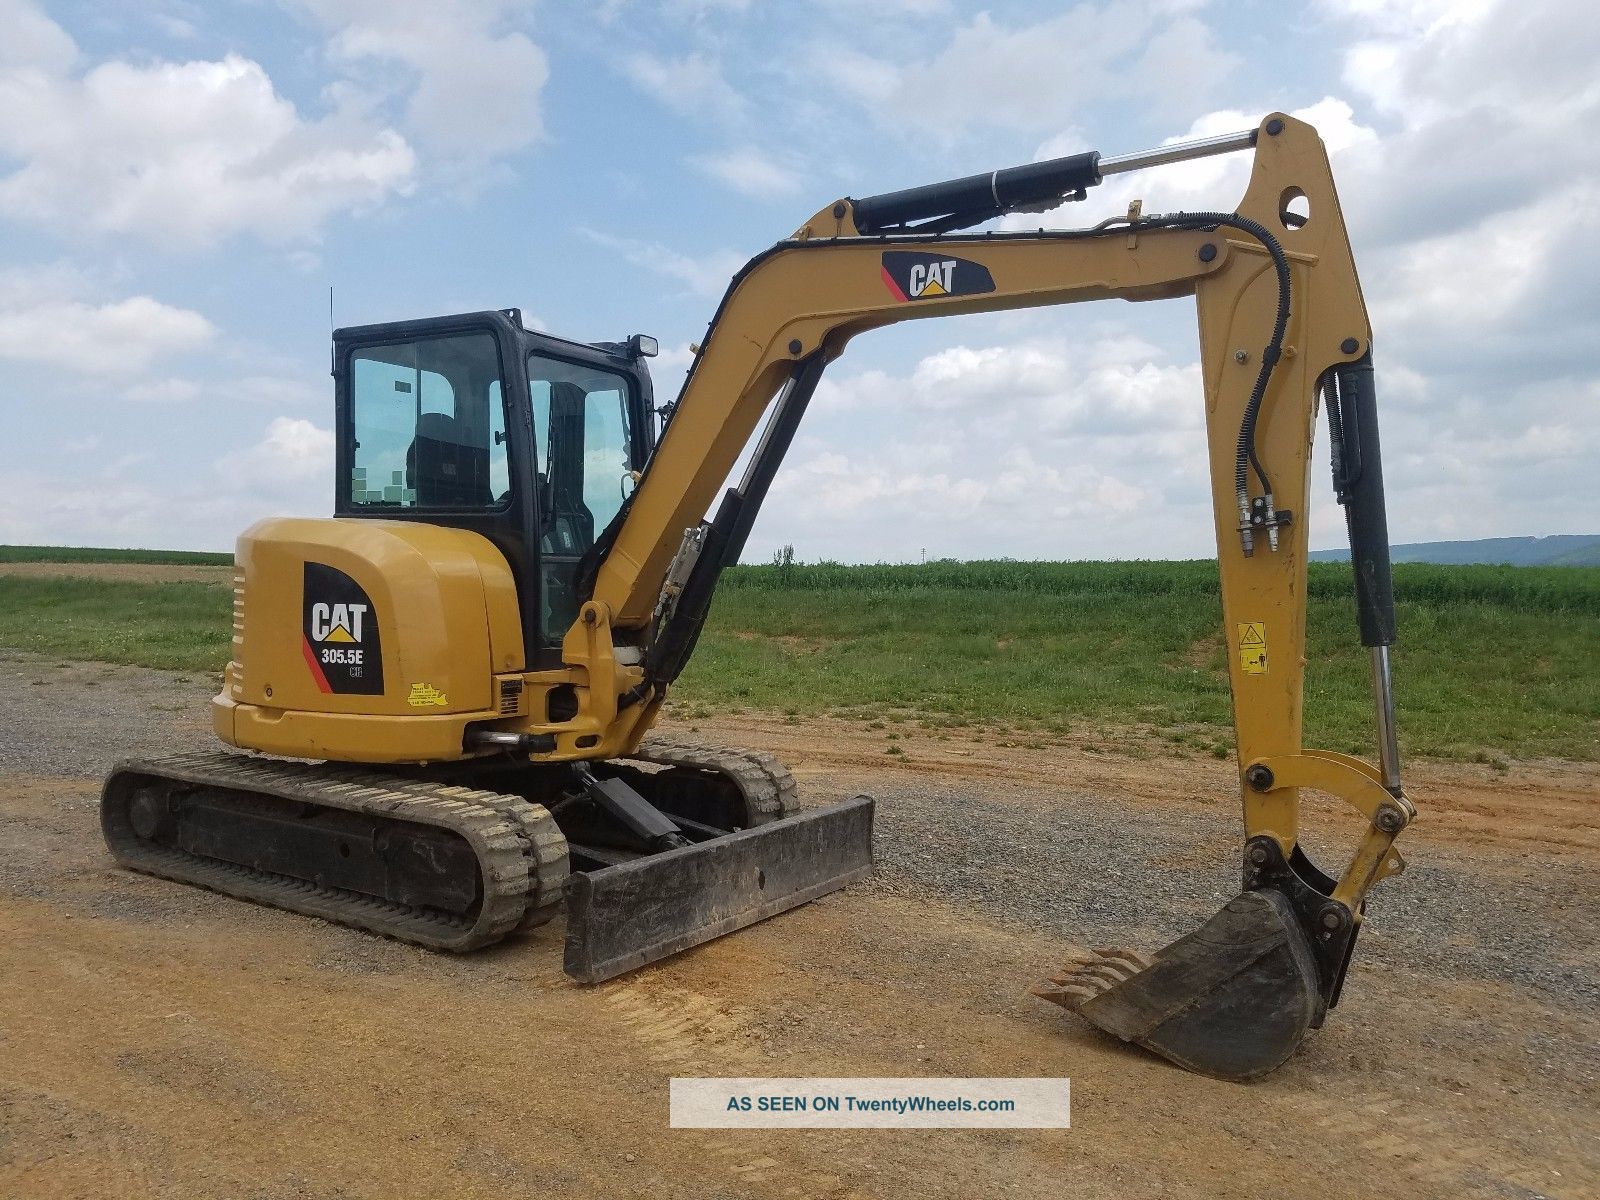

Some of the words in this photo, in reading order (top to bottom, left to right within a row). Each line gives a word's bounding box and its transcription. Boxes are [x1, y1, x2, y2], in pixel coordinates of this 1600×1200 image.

[909, 260, 957, 297] CAT
[311, 602, 367, 643] CAT
[321, 648, 364, 665] 305.5E
